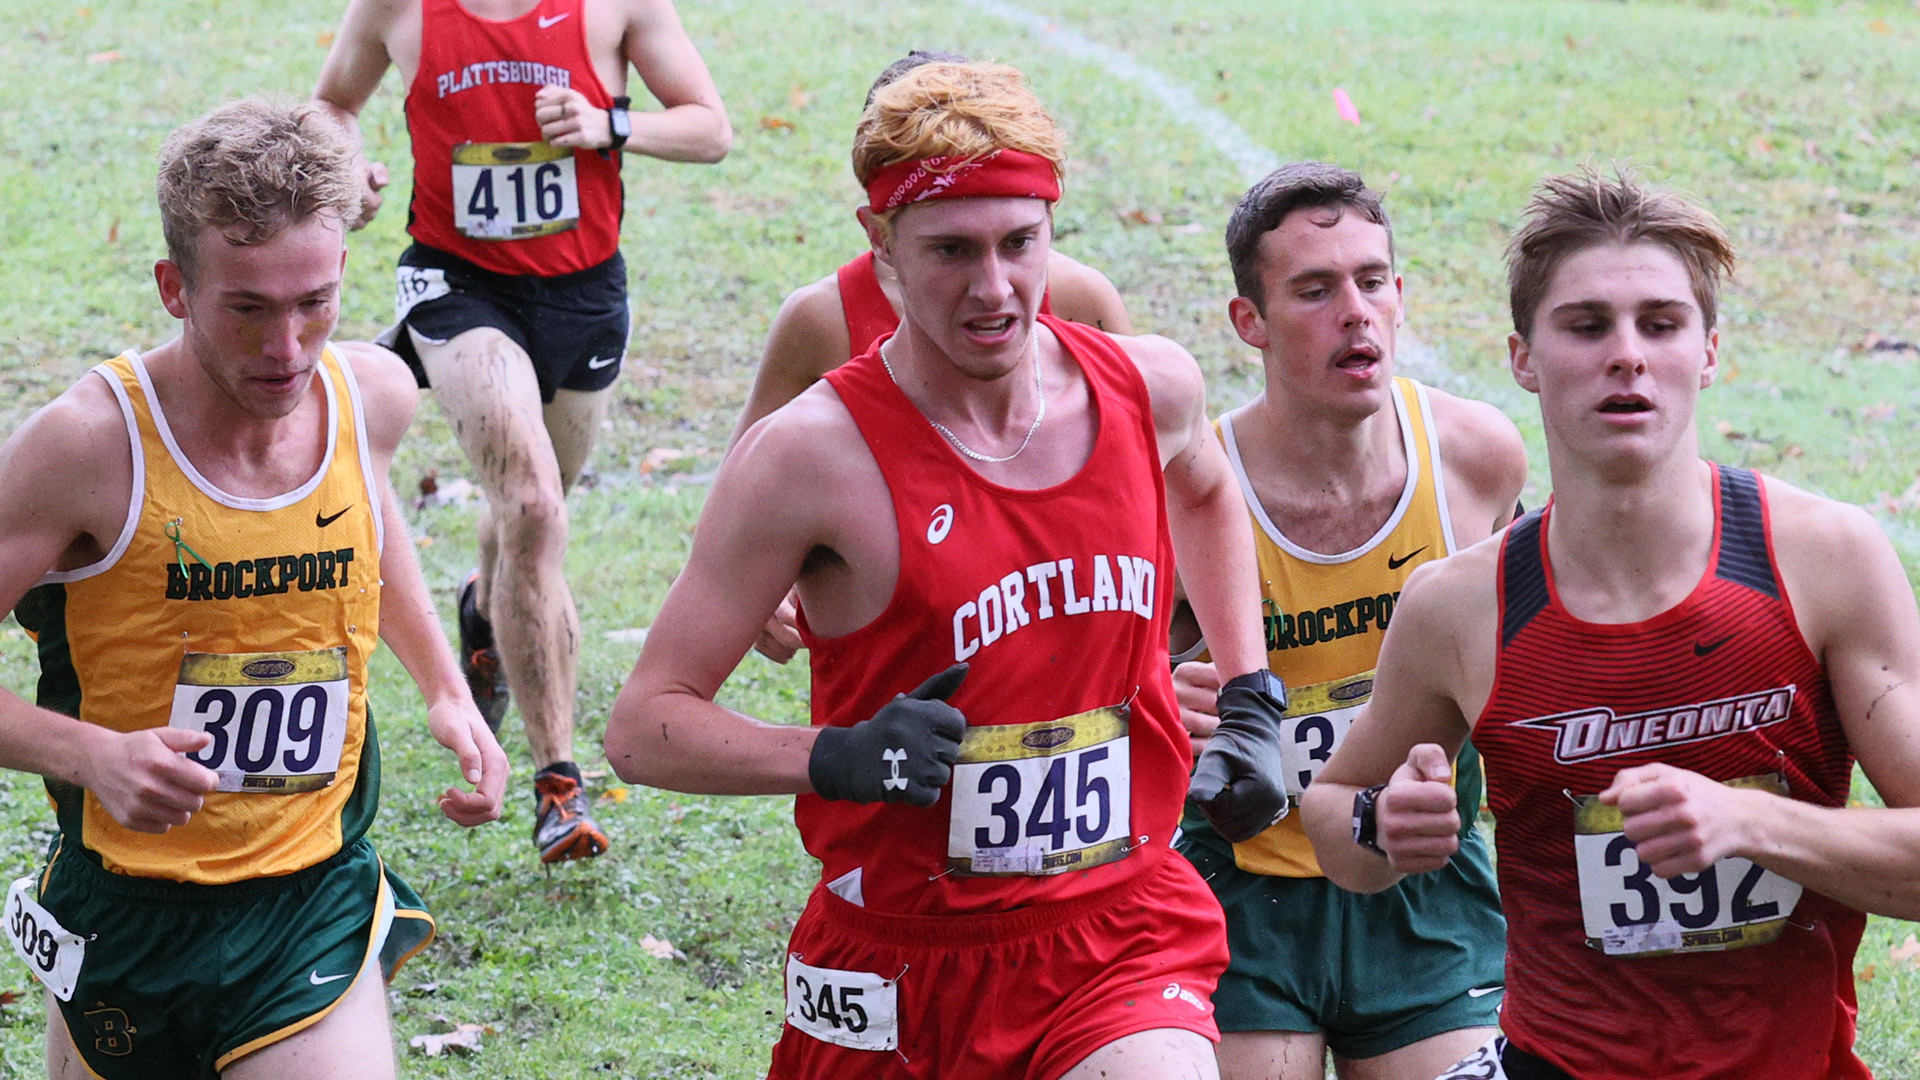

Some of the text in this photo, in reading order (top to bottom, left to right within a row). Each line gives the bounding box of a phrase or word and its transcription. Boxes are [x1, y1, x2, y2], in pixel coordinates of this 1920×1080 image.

[438, 60, 571, 98] PLATTSBURGH
[468, 163, 562, 223] 416
[165, 547, 354, 600] BROCKPORT
[953, 554, 1156, 663] CORTLAND
[1264, 592, 1400, 651] ROCKPO
[186, 685, 328, 773] 309
[1542, 688, 1790, 762] ONEONTA
[975, 746, 1111, 850] 345
[11, 893, 59, 972] 309
[796, 975, 869, 1033] 345
